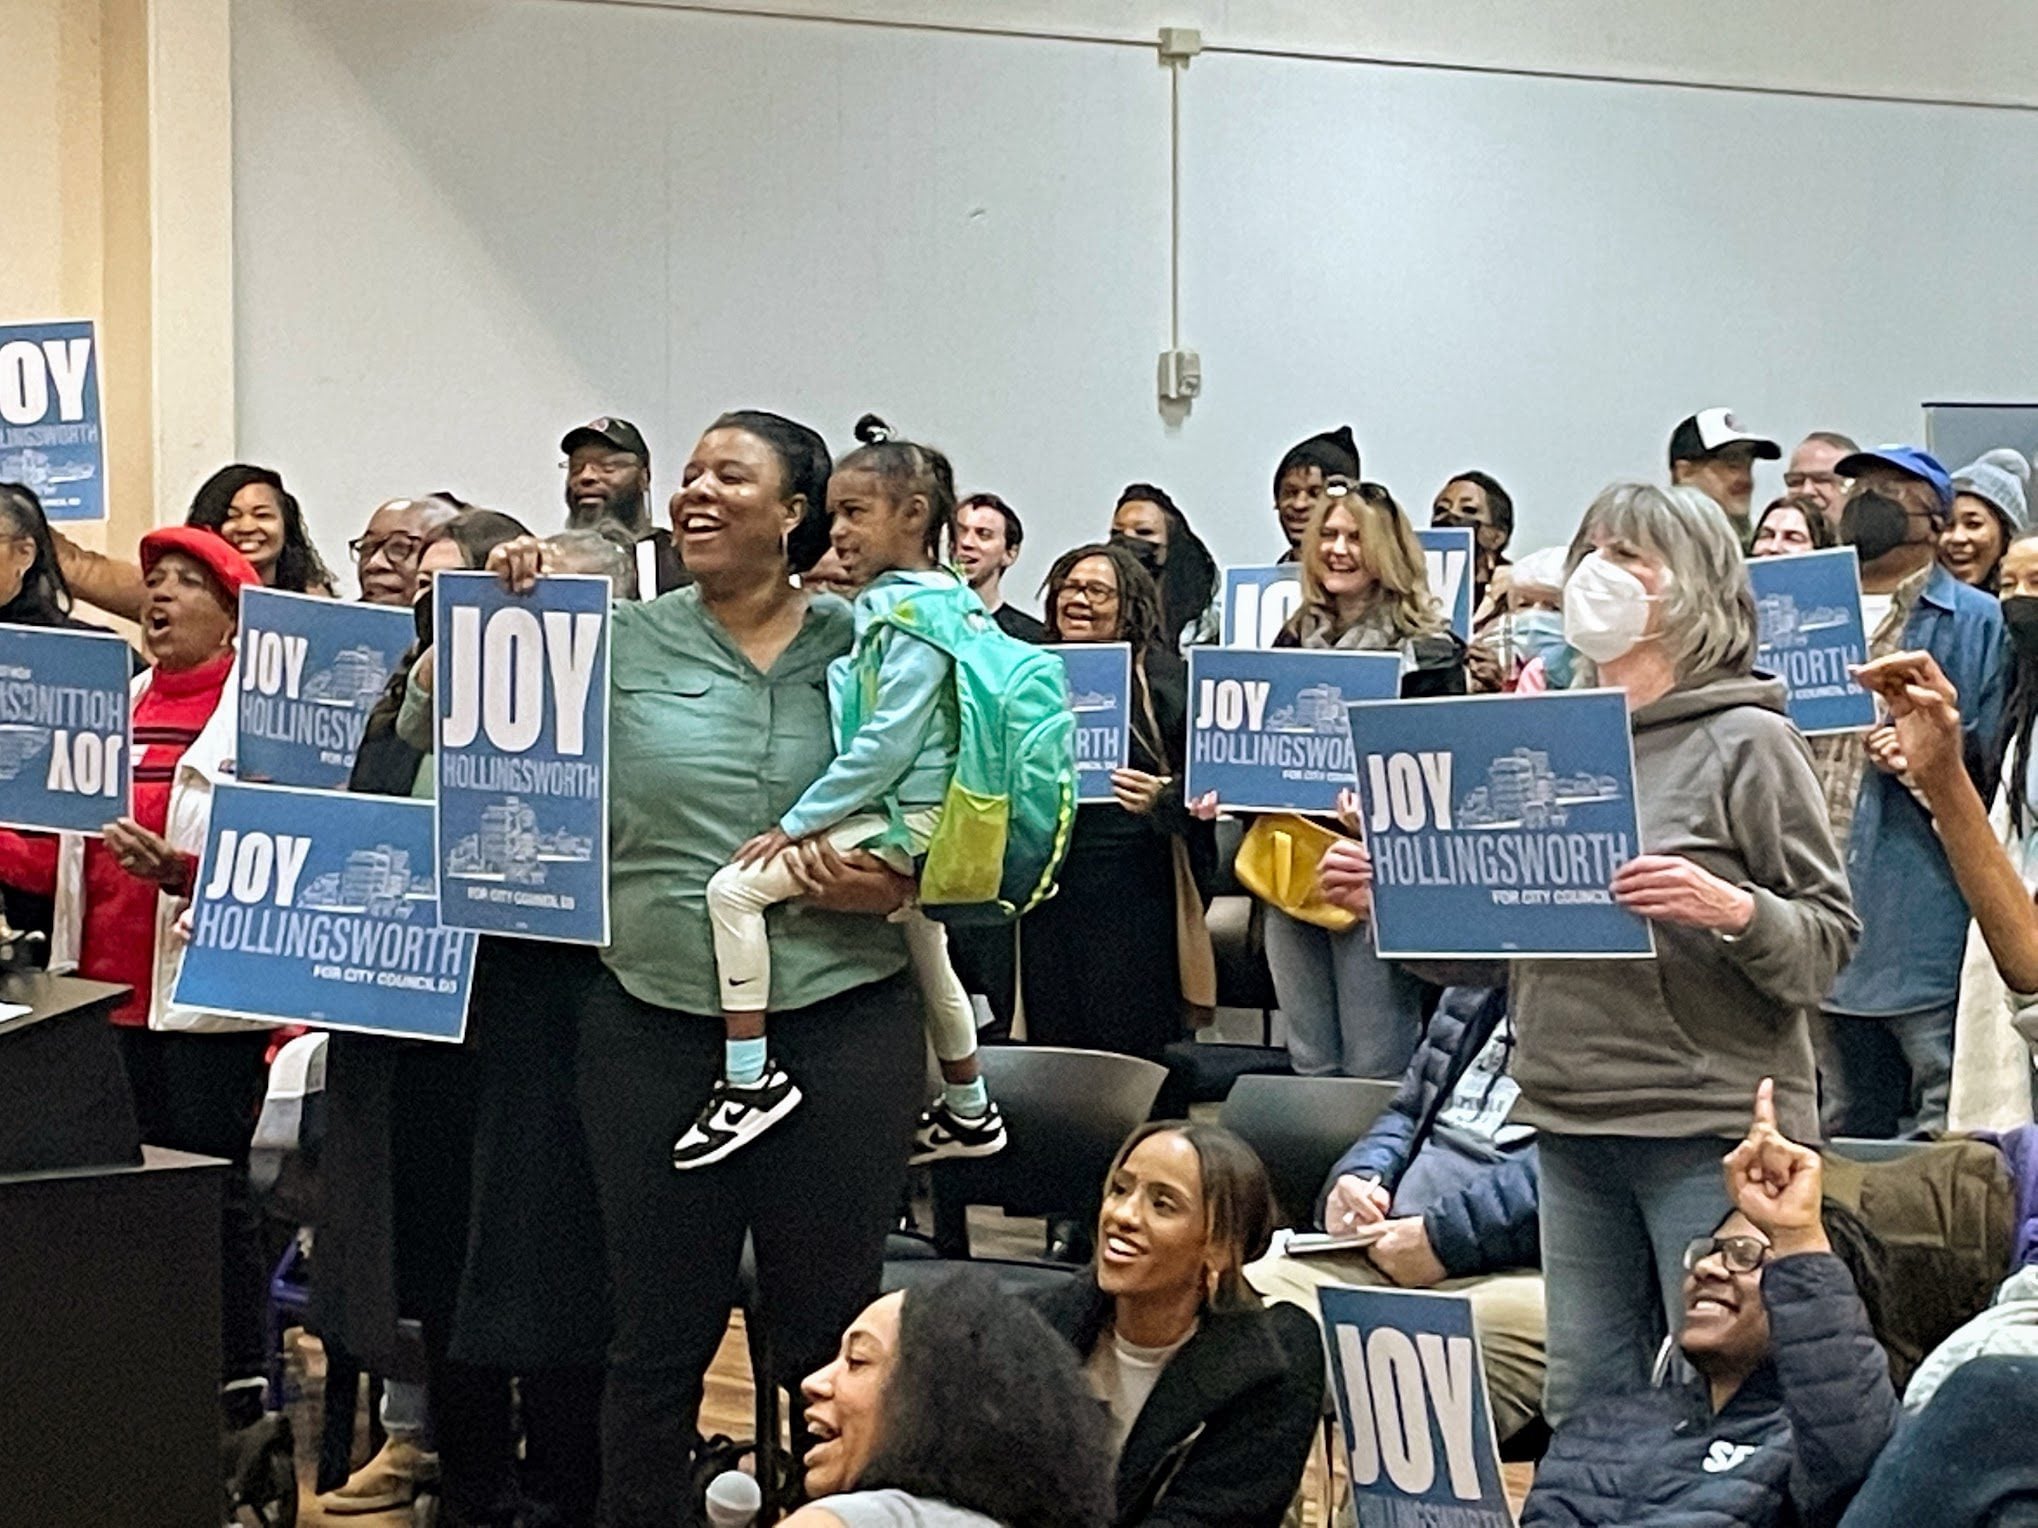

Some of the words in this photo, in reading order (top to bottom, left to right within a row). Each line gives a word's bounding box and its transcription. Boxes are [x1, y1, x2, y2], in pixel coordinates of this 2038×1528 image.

[242, 628, 309, 700] JOY
[442, 606, 602, 756] JOY
[1196, 679, 1271, 732] JOY
[47, 729, 124, 797] JOY
[442, 752, 600, 799] HOLLINGSWORTH
[1366, 751, 1453, 833] JOY
[204, 829, 313, 907] JOY
[1372, 832, 1628, 887] HOLLINGSWORTH
[195, 902, 465, 976] HOLLINGSWORTH
[313, 964, 342, 981] FOR
[343, 967, 377, 985] CITY
[377, 971, 436, 992] COUNCIL
[1336, 1323, 1483, 1500] JOY
